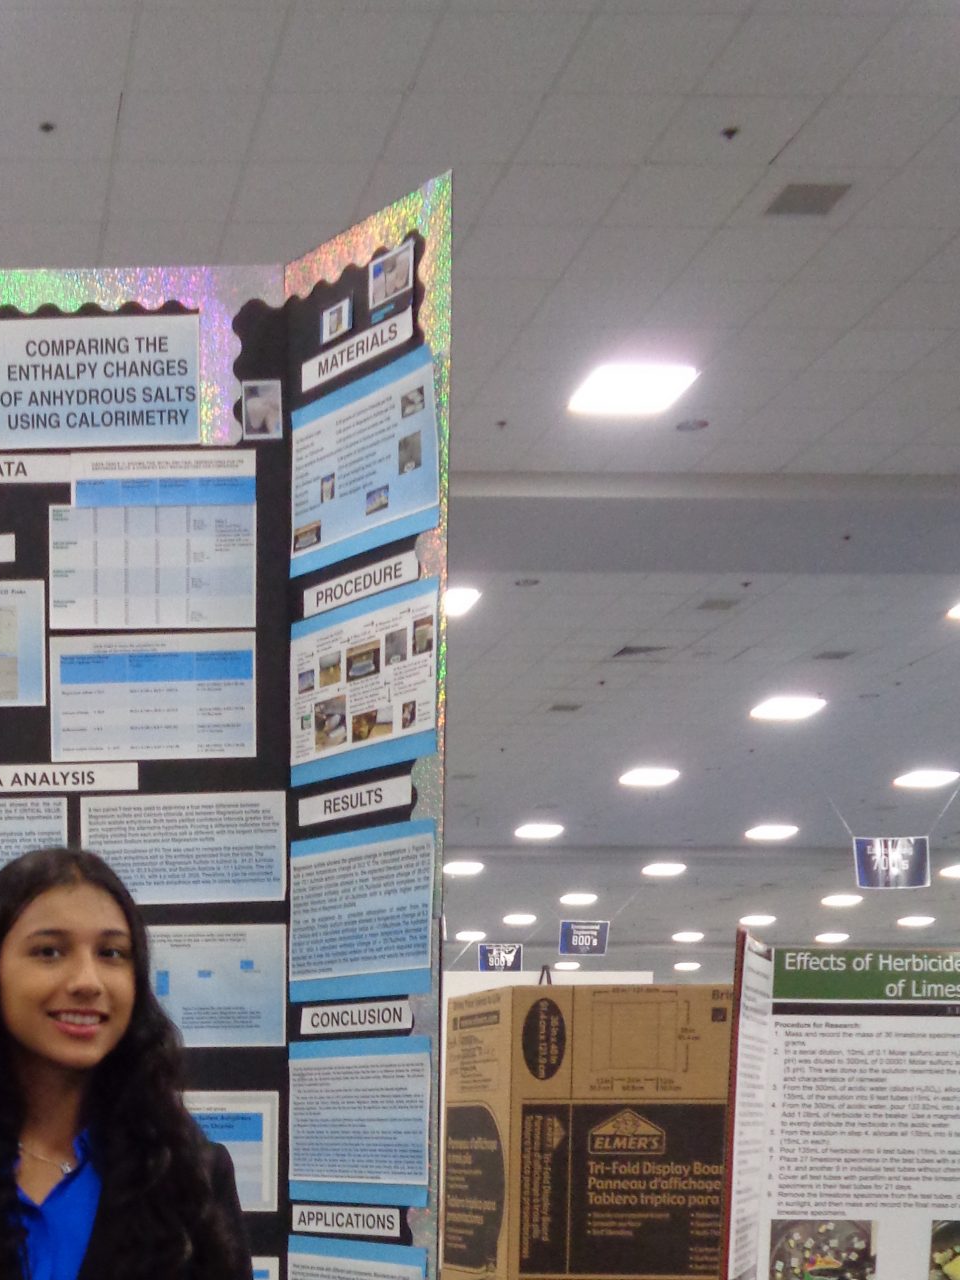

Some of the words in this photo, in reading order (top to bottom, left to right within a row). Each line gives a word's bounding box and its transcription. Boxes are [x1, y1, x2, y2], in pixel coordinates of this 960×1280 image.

[26, 339, 130, 358] COMPARING
[135, 337, 169, 354] THE
[318, 324, 398, 378] MATERIALS
[7, 363, 98, 382] ENTHALPY
[103, 360, 189, 378] CHANGES
[0, 390, 23, 408] OF
[28, 387, 136, 406] ANHYDROUS
[142, 385, 196, 404] SALTS
[7, 412, 61, 430] USING
[66, 408, 189, 428] CALORIMETRY
[316, 562, 402, 608] PROCEDURE
[10, 770, 95, 787] ANALYSIS
[324, 788, 383, 815] RESULTS
[572, 935, 598, 947] 800's
[785, 952, 846, 971] Effects
[852, 953, 873, 971] of
[885, 980, 906, 997] of
[311, 1007, 403, 1028] CONCLUSION
[594, 1137, 659, 1149] ELMER'S
[588, 1162, 640, 1175] Tri-Fold
[643, 1162, 690, 1177] Display
[588, 1178, 645, 1190] Panneau
[588, 1193, 638, 1205] Tablero
[688, 1195, 720, 1207] para
[297, 1211, 395, 1231] APPLICATIONS
